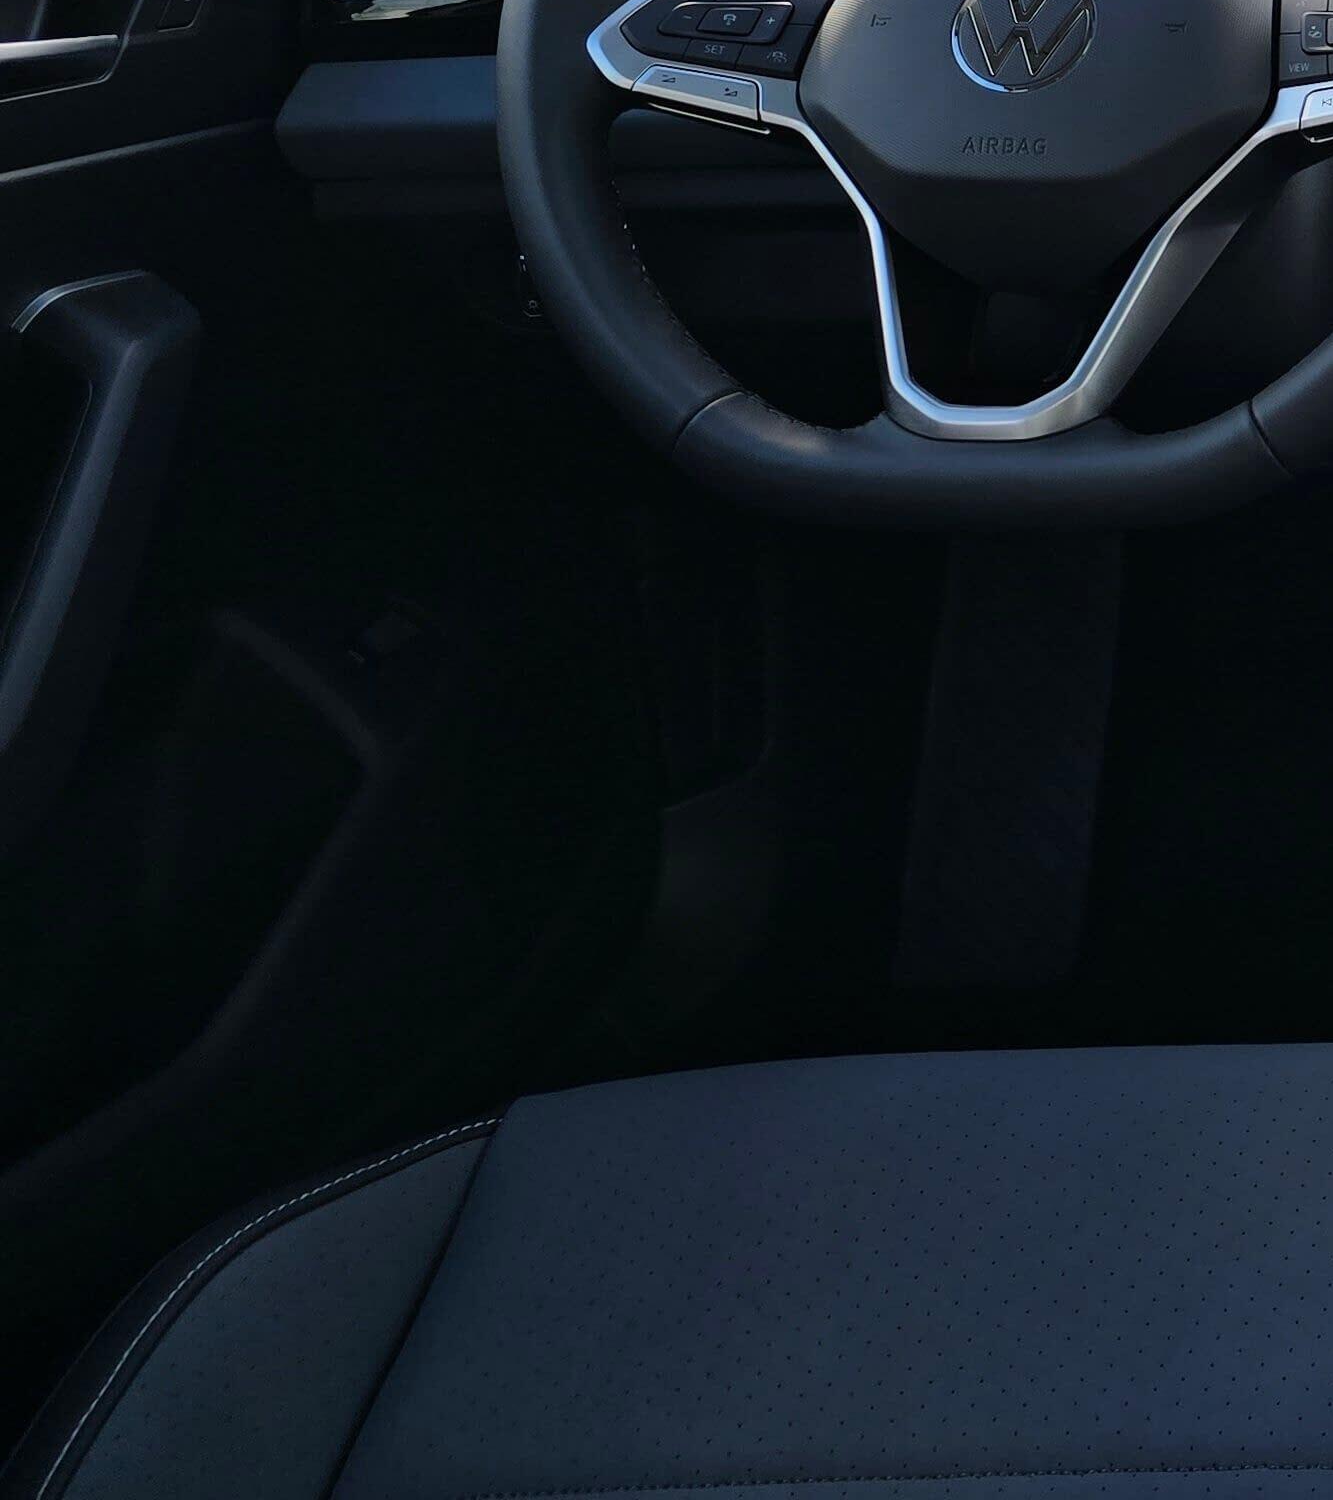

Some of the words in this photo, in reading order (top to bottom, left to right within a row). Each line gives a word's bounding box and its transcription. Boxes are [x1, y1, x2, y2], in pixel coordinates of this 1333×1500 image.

[704, 44, 725, 54] SET
[1288, 62, 1309, 72] VIEW
[962, 136, 1048, 155] AIRBAG
